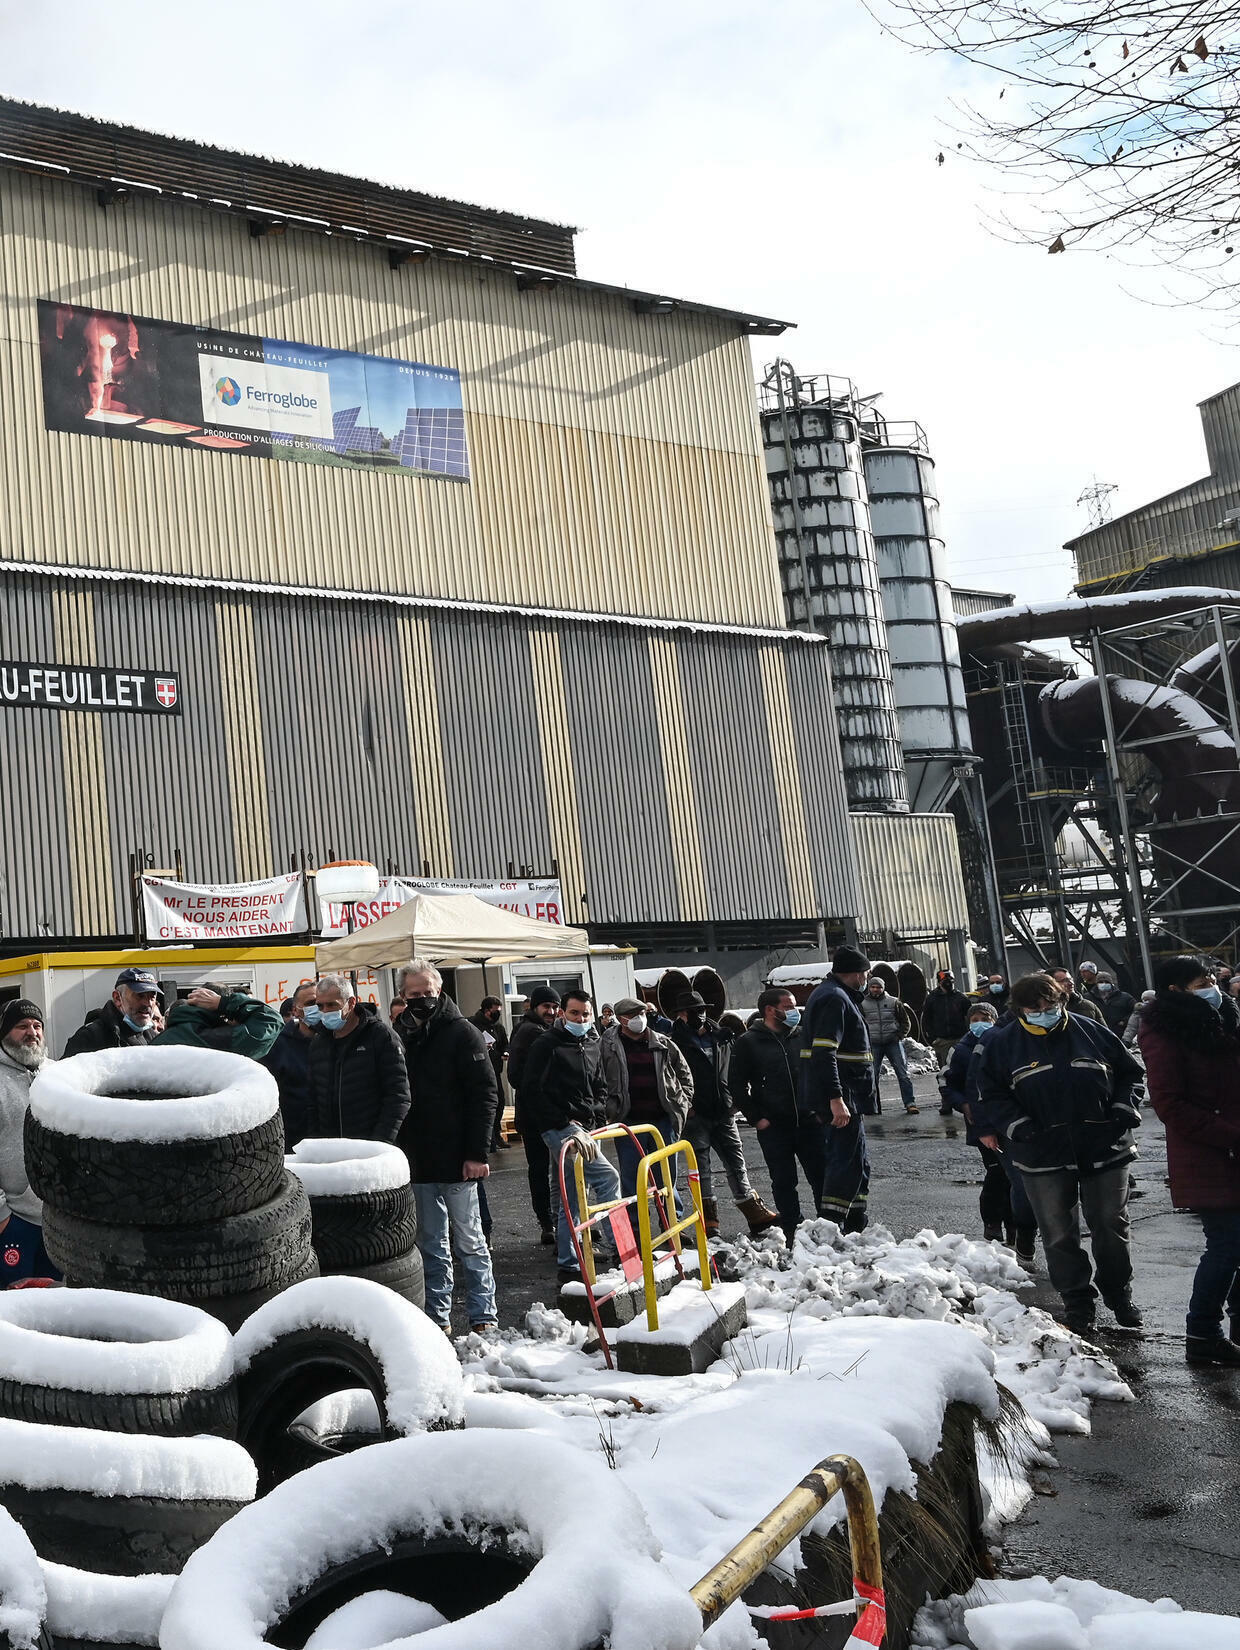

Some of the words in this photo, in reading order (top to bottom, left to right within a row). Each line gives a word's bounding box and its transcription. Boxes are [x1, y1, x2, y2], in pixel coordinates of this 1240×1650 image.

[196, 342, 224, 352] USINE
[228, 346, 239, 355] DE
[399, 366, 430, 377] DEPUIS
[246, 386, 318, 409] Ferroglobe
[203, 429, 252, 442] PRODUCTION
[253, 435, 294, 448] D'ALLIAGES
[294, 440, 305, 449] DE
[306, 441, 337, 454] SILICIUM
[285, 873, 301, 883] CGT
[500, 882, 518, 891] CGT
[164, 897, 183, 908] Mr
[187, 897, 206, 908] LE
[210, 893, 286, 909] PRESIDENT
[182, 911, 225, 923] NOUS
[228, 909, 271, 923] AIDER
[159, 926, 201, 938] C'EST
[203, 921, 294, 938] MAINTENANT
[264, 979, 289, 1005] LE
